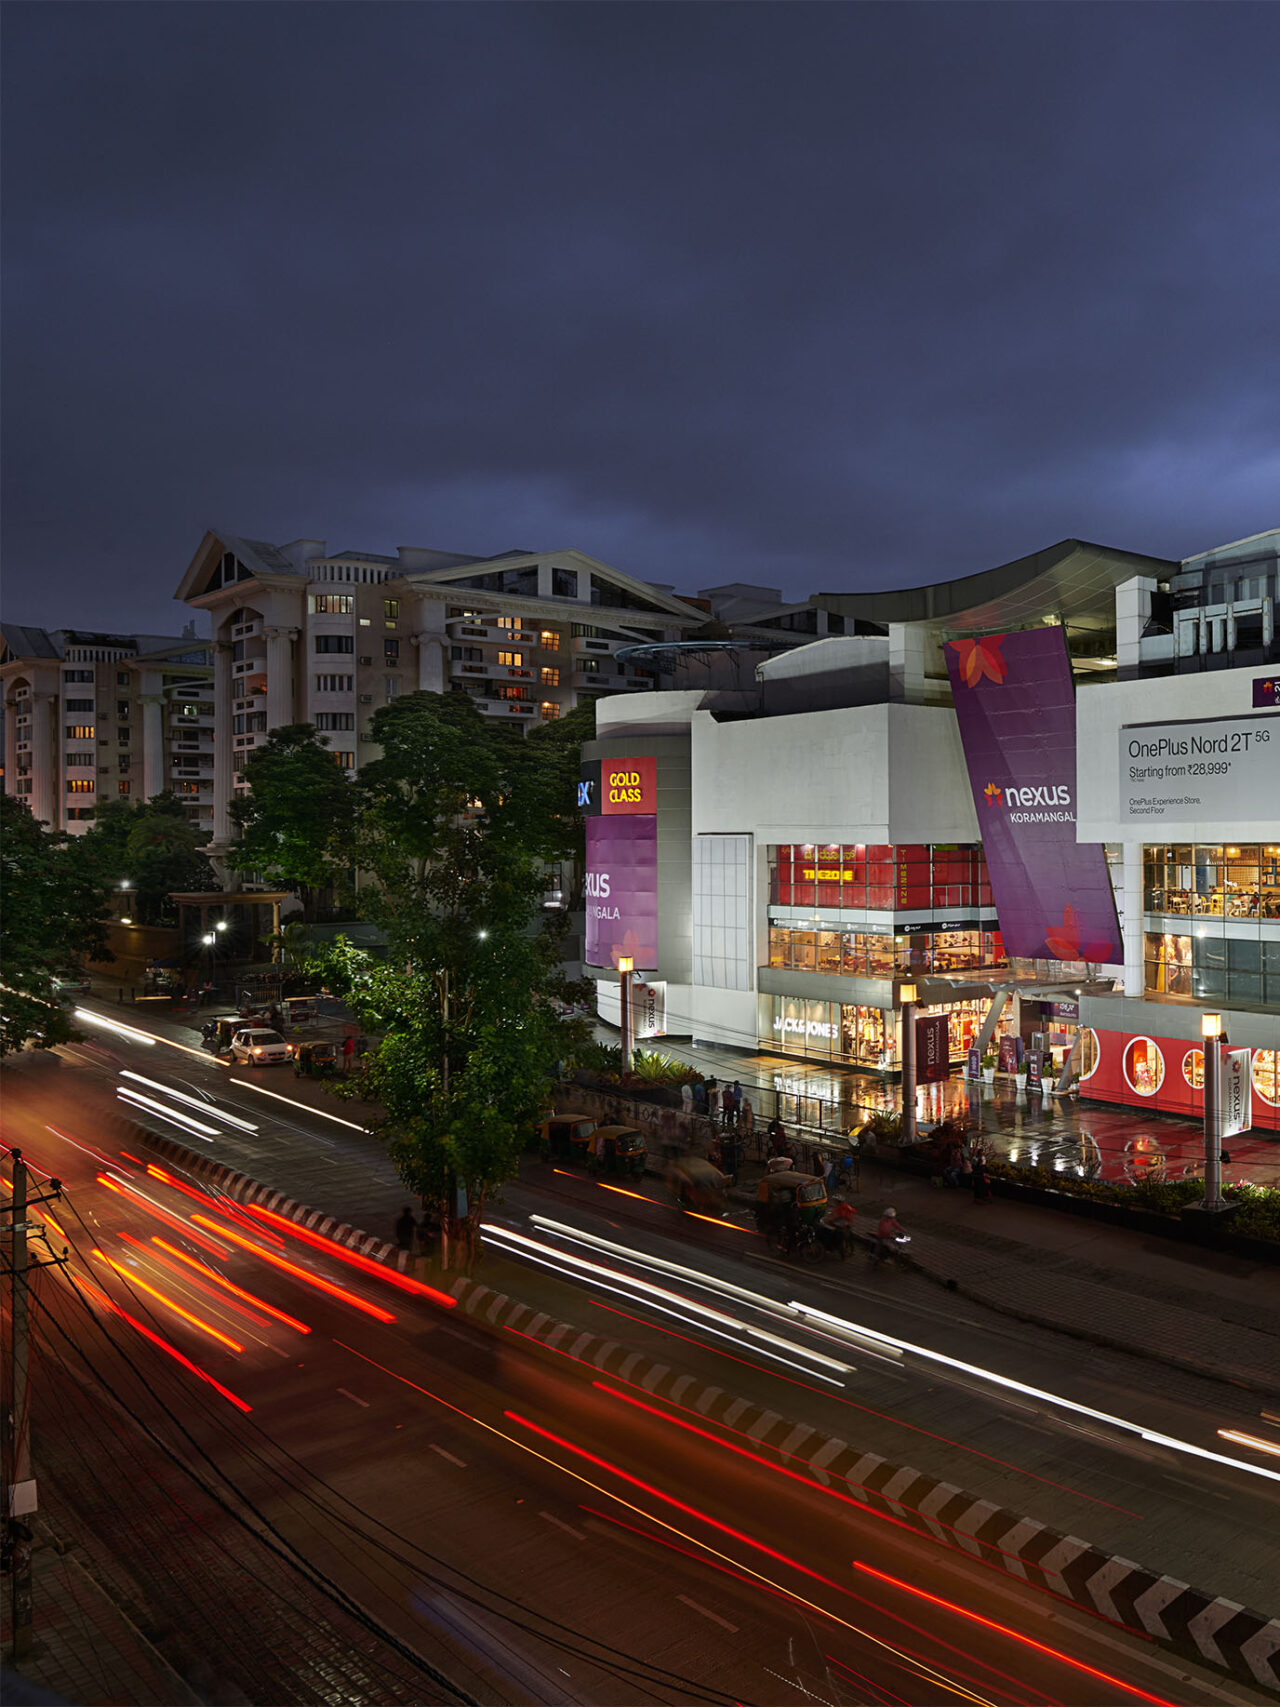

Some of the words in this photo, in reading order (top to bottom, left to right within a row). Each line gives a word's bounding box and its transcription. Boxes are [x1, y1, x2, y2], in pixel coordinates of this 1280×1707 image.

[1128, 738, 1189, 758] OnePlus
[1191, 734, 1228, 754] Nord
[1231, 732, 1252, 752] 2T
[1255, 730, 1271, 743] 5G
[609, 772, 640, 786] GOLD
[1129, 766, 1164, 779] Starting
[1165, 764, 1186, 777] from
[609, 788, 642, 803] CLASS
[1005, 785, 1071, 807] nexus
[1128, 797, 1152, 806] OnePlus
[1152, 797, 1183, 806] Experience
[1129, 806, 1151, 815] Second
[1151, 806, 1165, 814] Floor
[648, 998, 656, 1029] nexus
[927, 1027, 936, 1065] nexus
[1232, 1075, 1241, 1121] nexus
